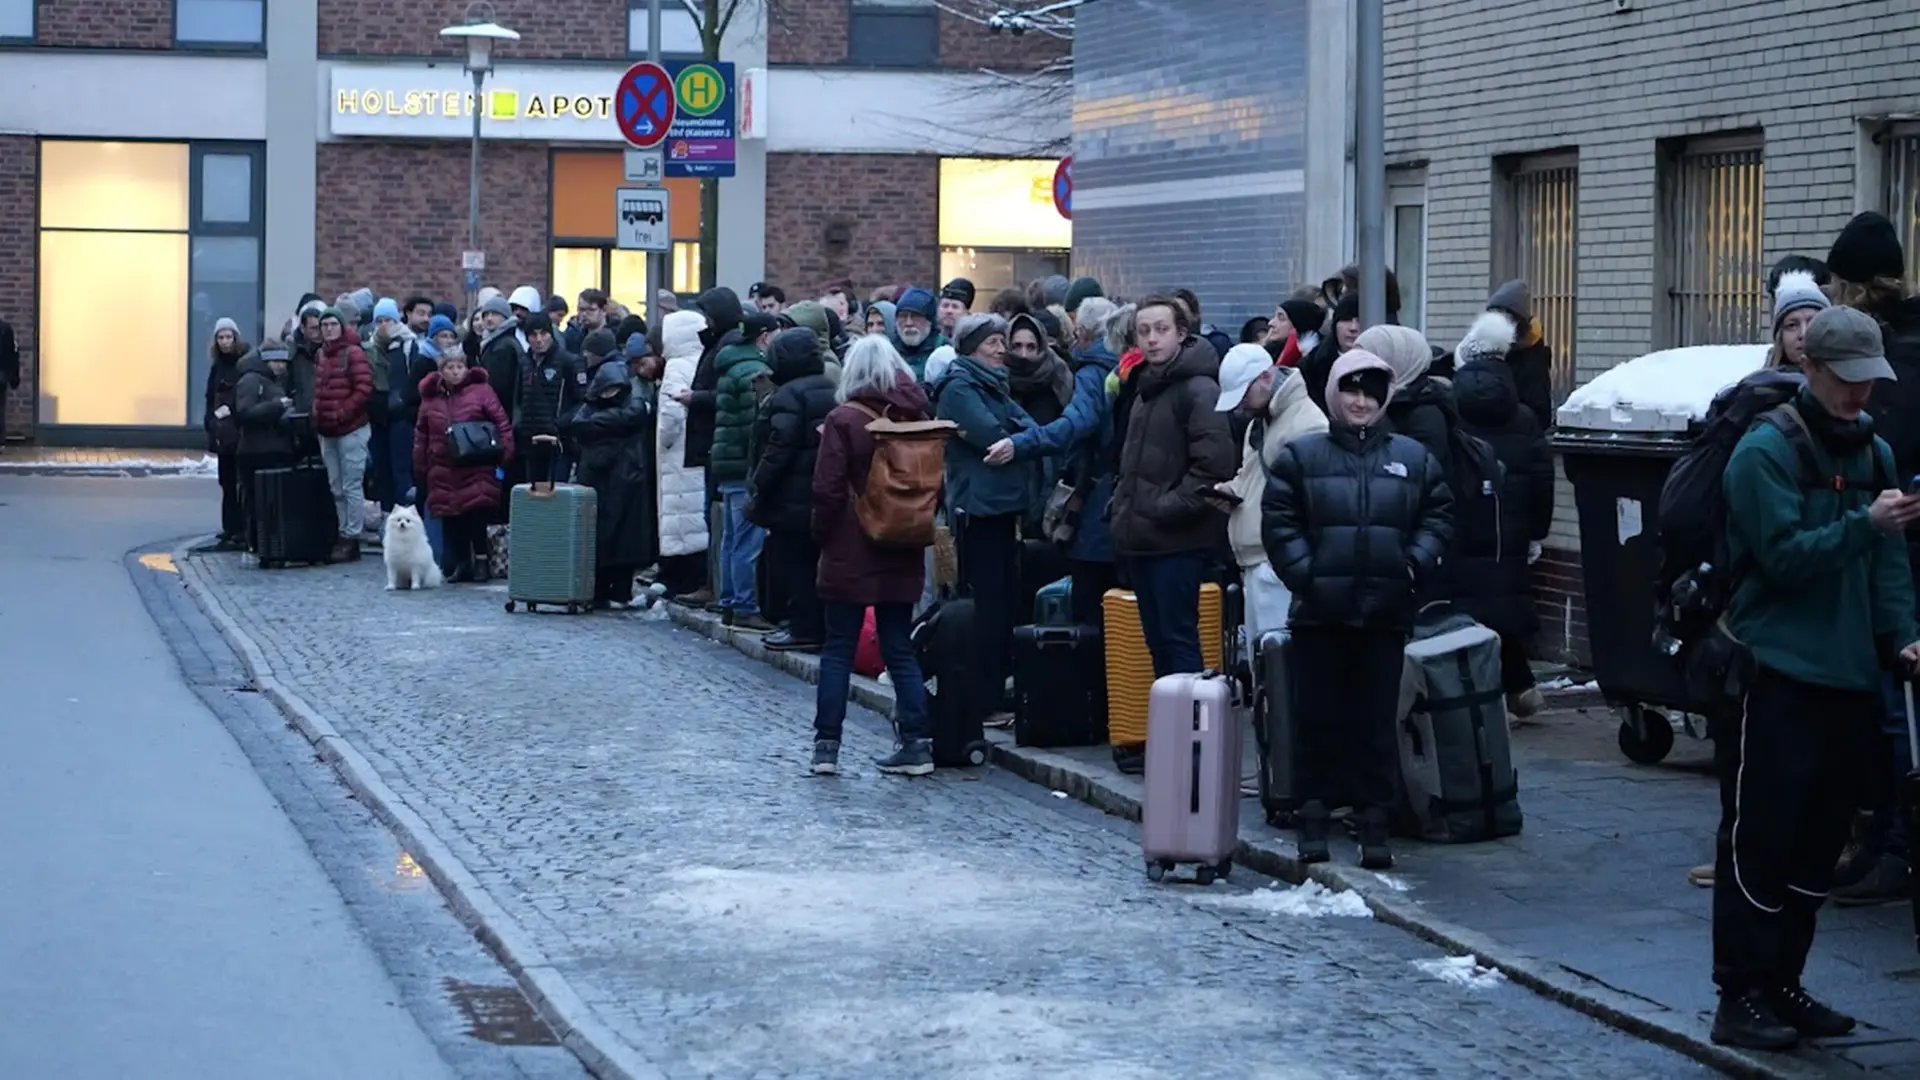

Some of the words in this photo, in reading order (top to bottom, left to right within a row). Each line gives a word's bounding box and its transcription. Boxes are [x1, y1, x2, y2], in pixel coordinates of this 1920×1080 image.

[337, 89, 485, 116] HOLSTEN
[525, 94, 612, 119] APOT
[689, 76, 709, 104] H
[634, 228, 653, 244] frei
